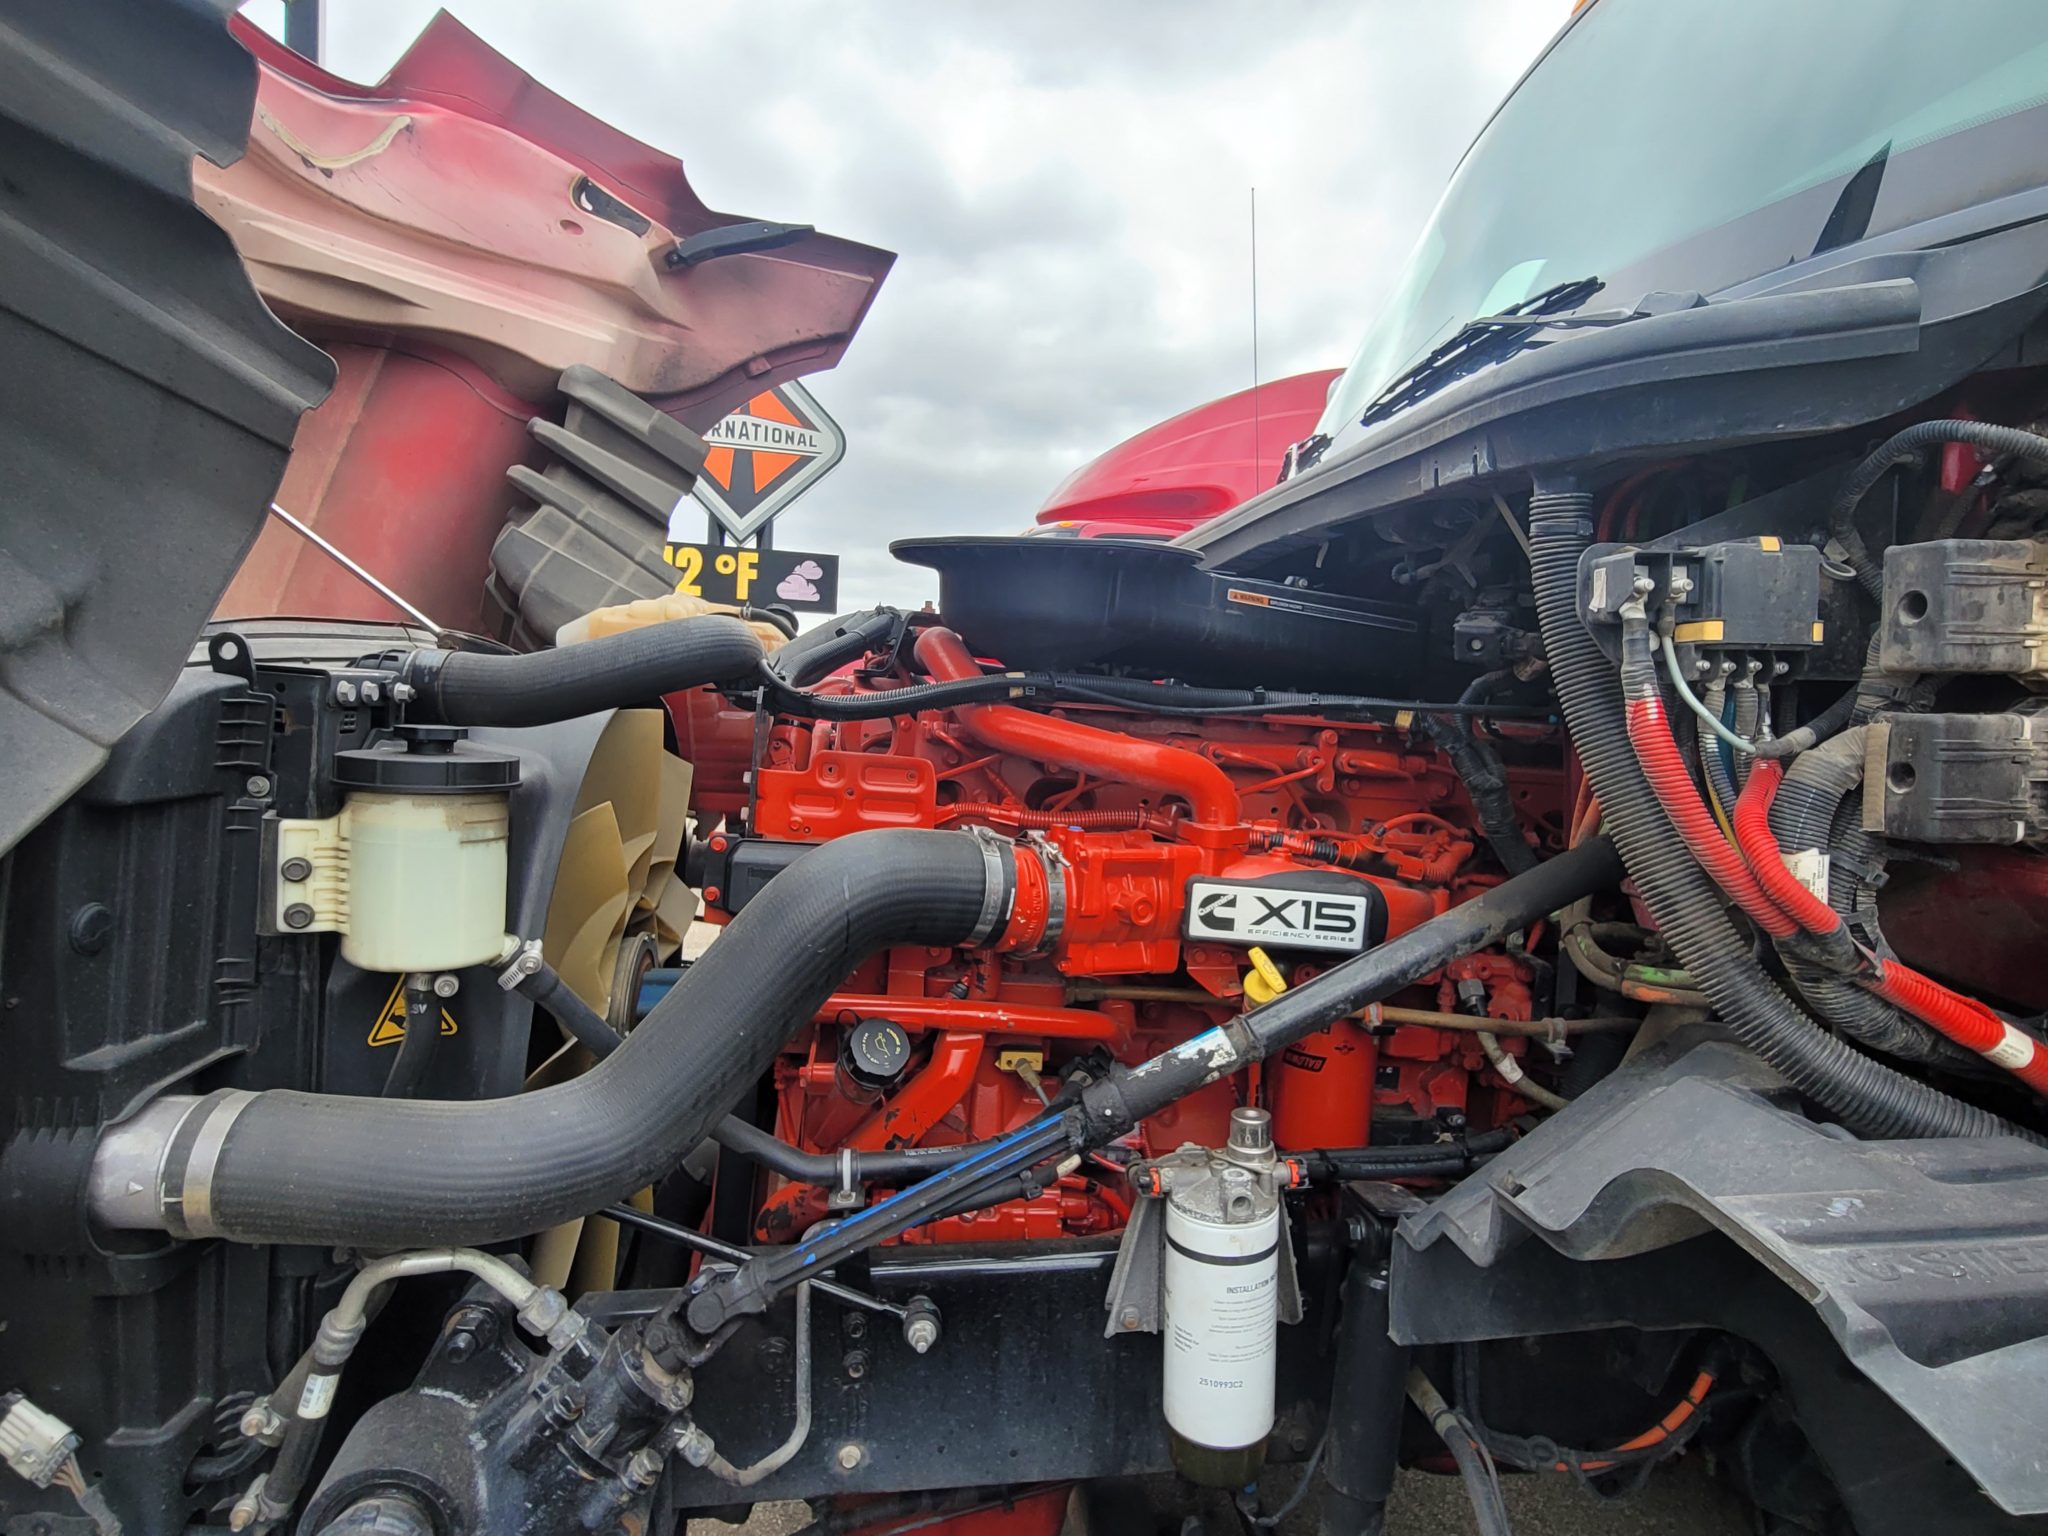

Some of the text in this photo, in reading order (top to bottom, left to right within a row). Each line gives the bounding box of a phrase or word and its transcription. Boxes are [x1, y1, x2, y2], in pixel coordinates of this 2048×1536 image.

[704, 420, 818, 448] RNATIONAL
[1249, 896, 1357, 933] X15
[1247, 929, 1355, 942] EFFICIENCY SERIES
[1226, 1279, 1269, 1294] INSTALLATION
[1199, 1377, 1243, 1389] 2510993C2
